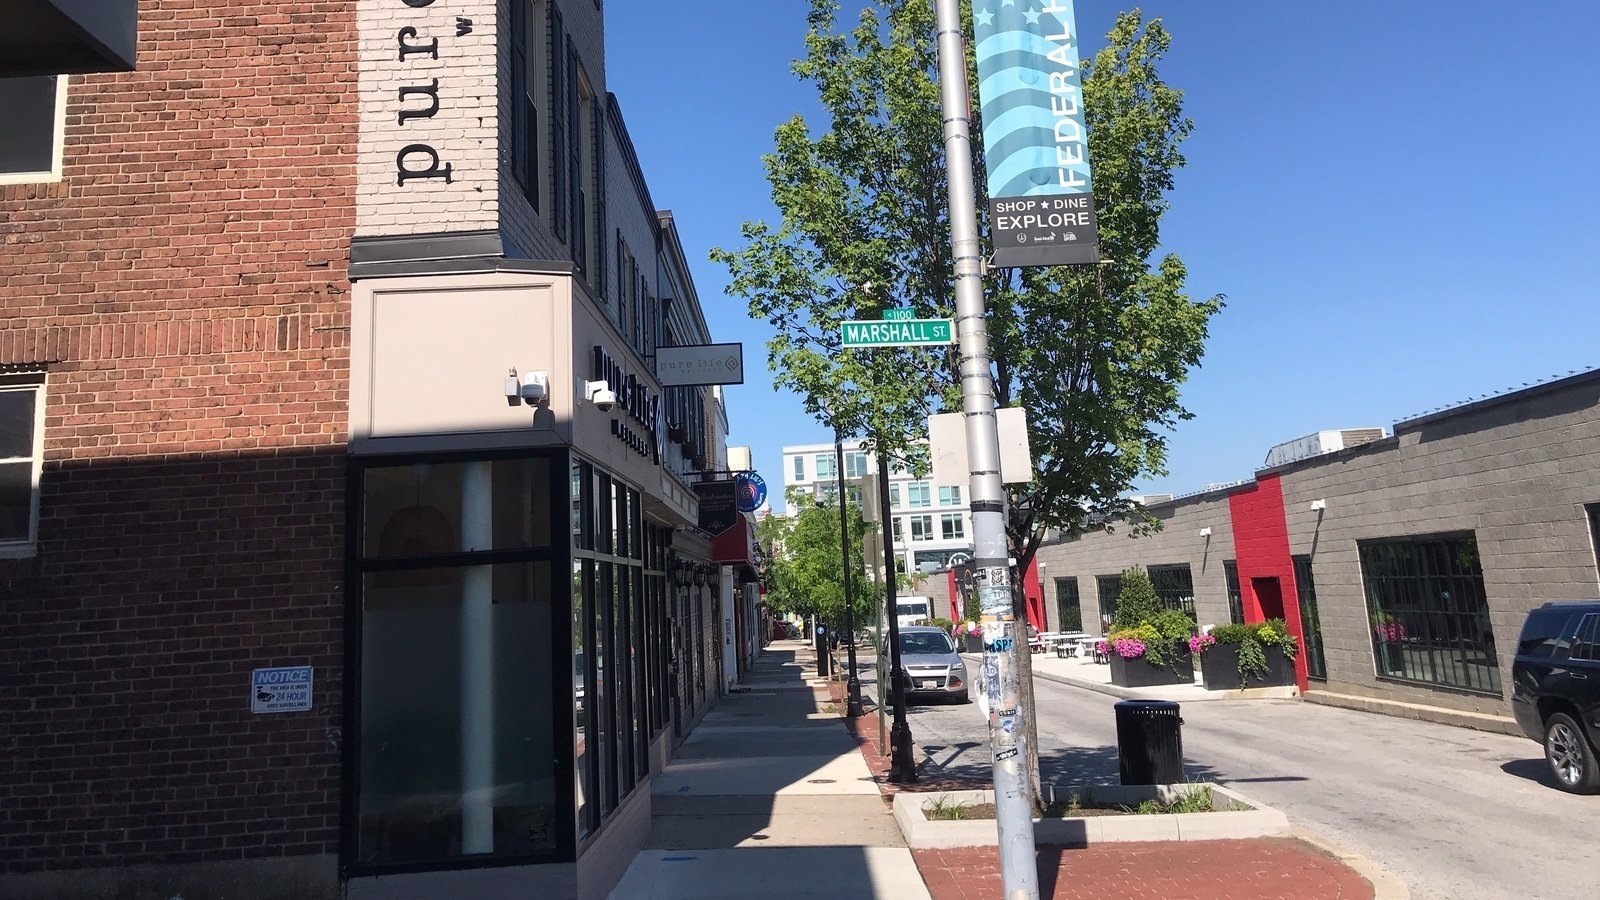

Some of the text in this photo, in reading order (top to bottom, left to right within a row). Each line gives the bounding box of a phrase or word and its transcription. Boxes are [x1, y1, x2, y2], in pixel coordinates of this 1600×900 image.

[397, 0, 451, 187] pur
[1044, 21, 1086, 188] FEDERAL
[996, 197, 1088, 213] SHOP DINE
[997, 212, 1090, 230] EXPLORE
[893, 310, 912, 320] 1100
[847, 324, 930, 343] MARSHALL
[660, 361, 693, 371] pure
[698, 359, 722, 368] life
[258, 670, 309, 684] NOTICE
[276, 692, 307, 701] 24 HOUR
